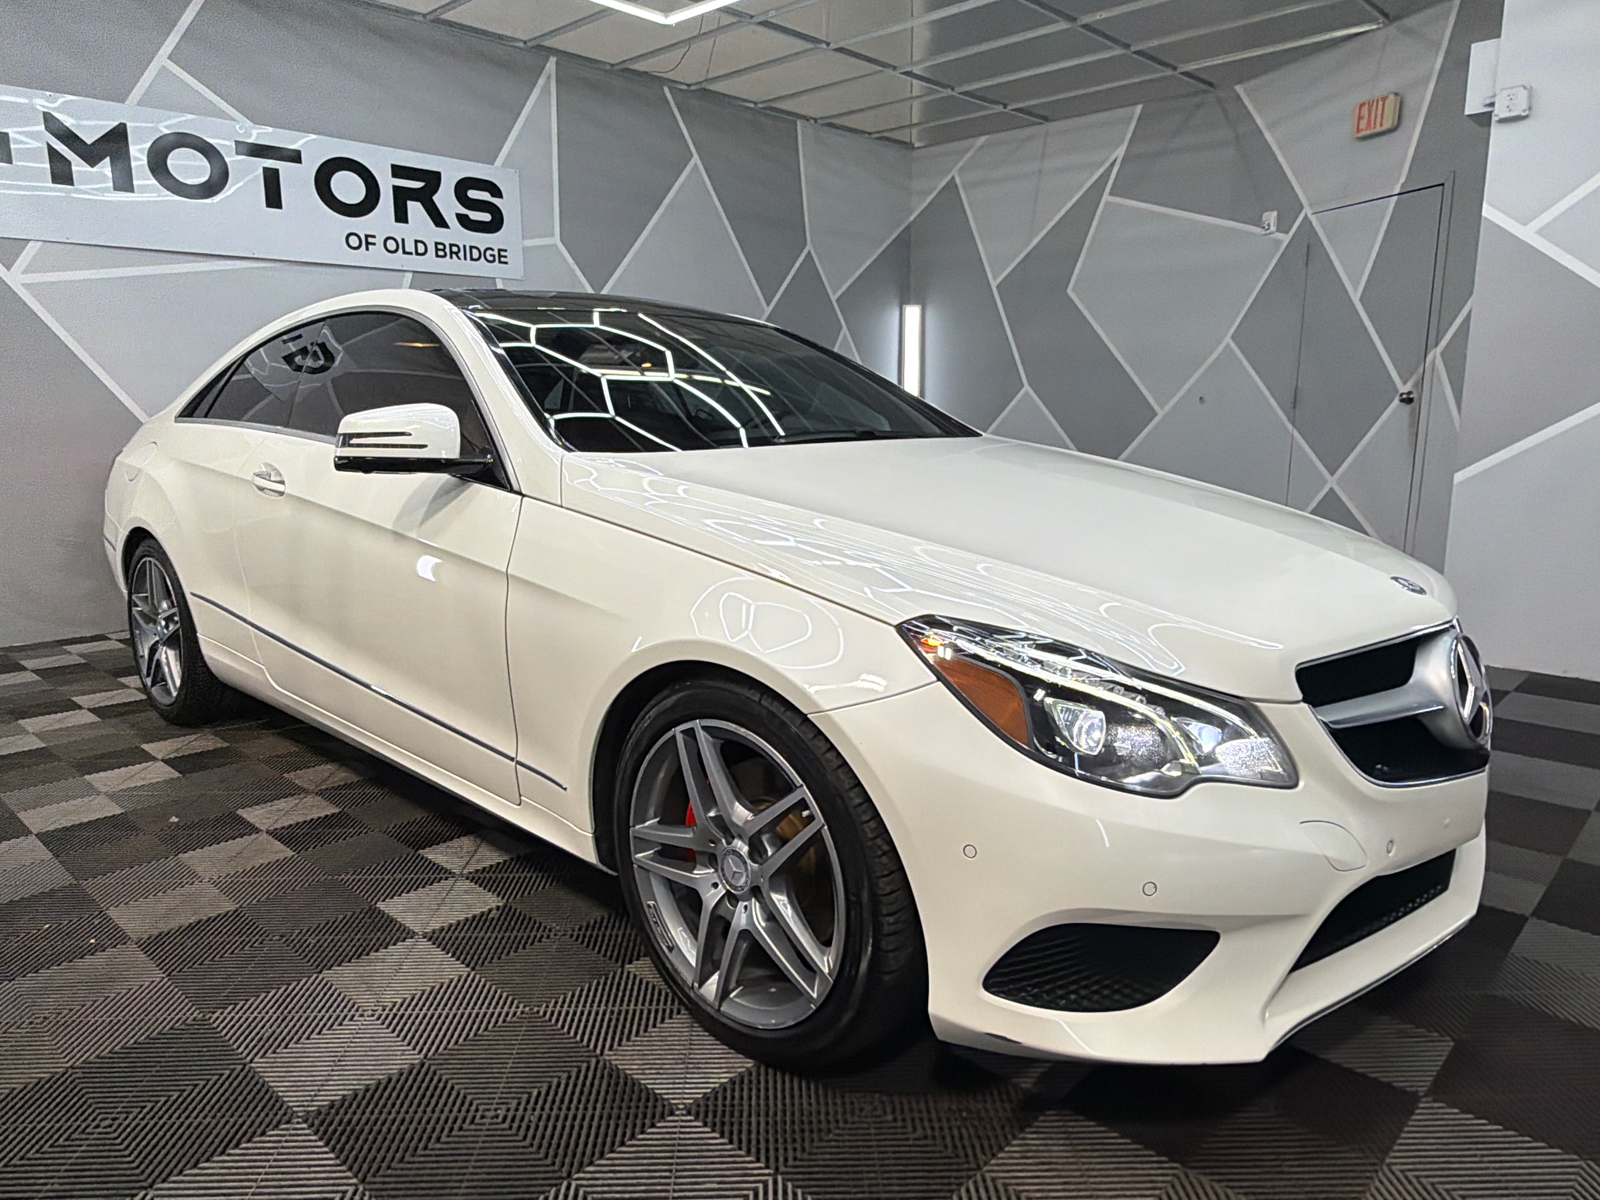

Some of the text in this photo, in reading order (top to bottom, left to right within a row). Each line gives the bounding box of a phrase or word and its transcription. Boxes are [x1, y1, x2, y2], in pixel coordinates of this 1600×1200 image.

[1356, 95, 1389, 134] EXIT
[345, 231, 509, 265] OF OLD BRIDGE
